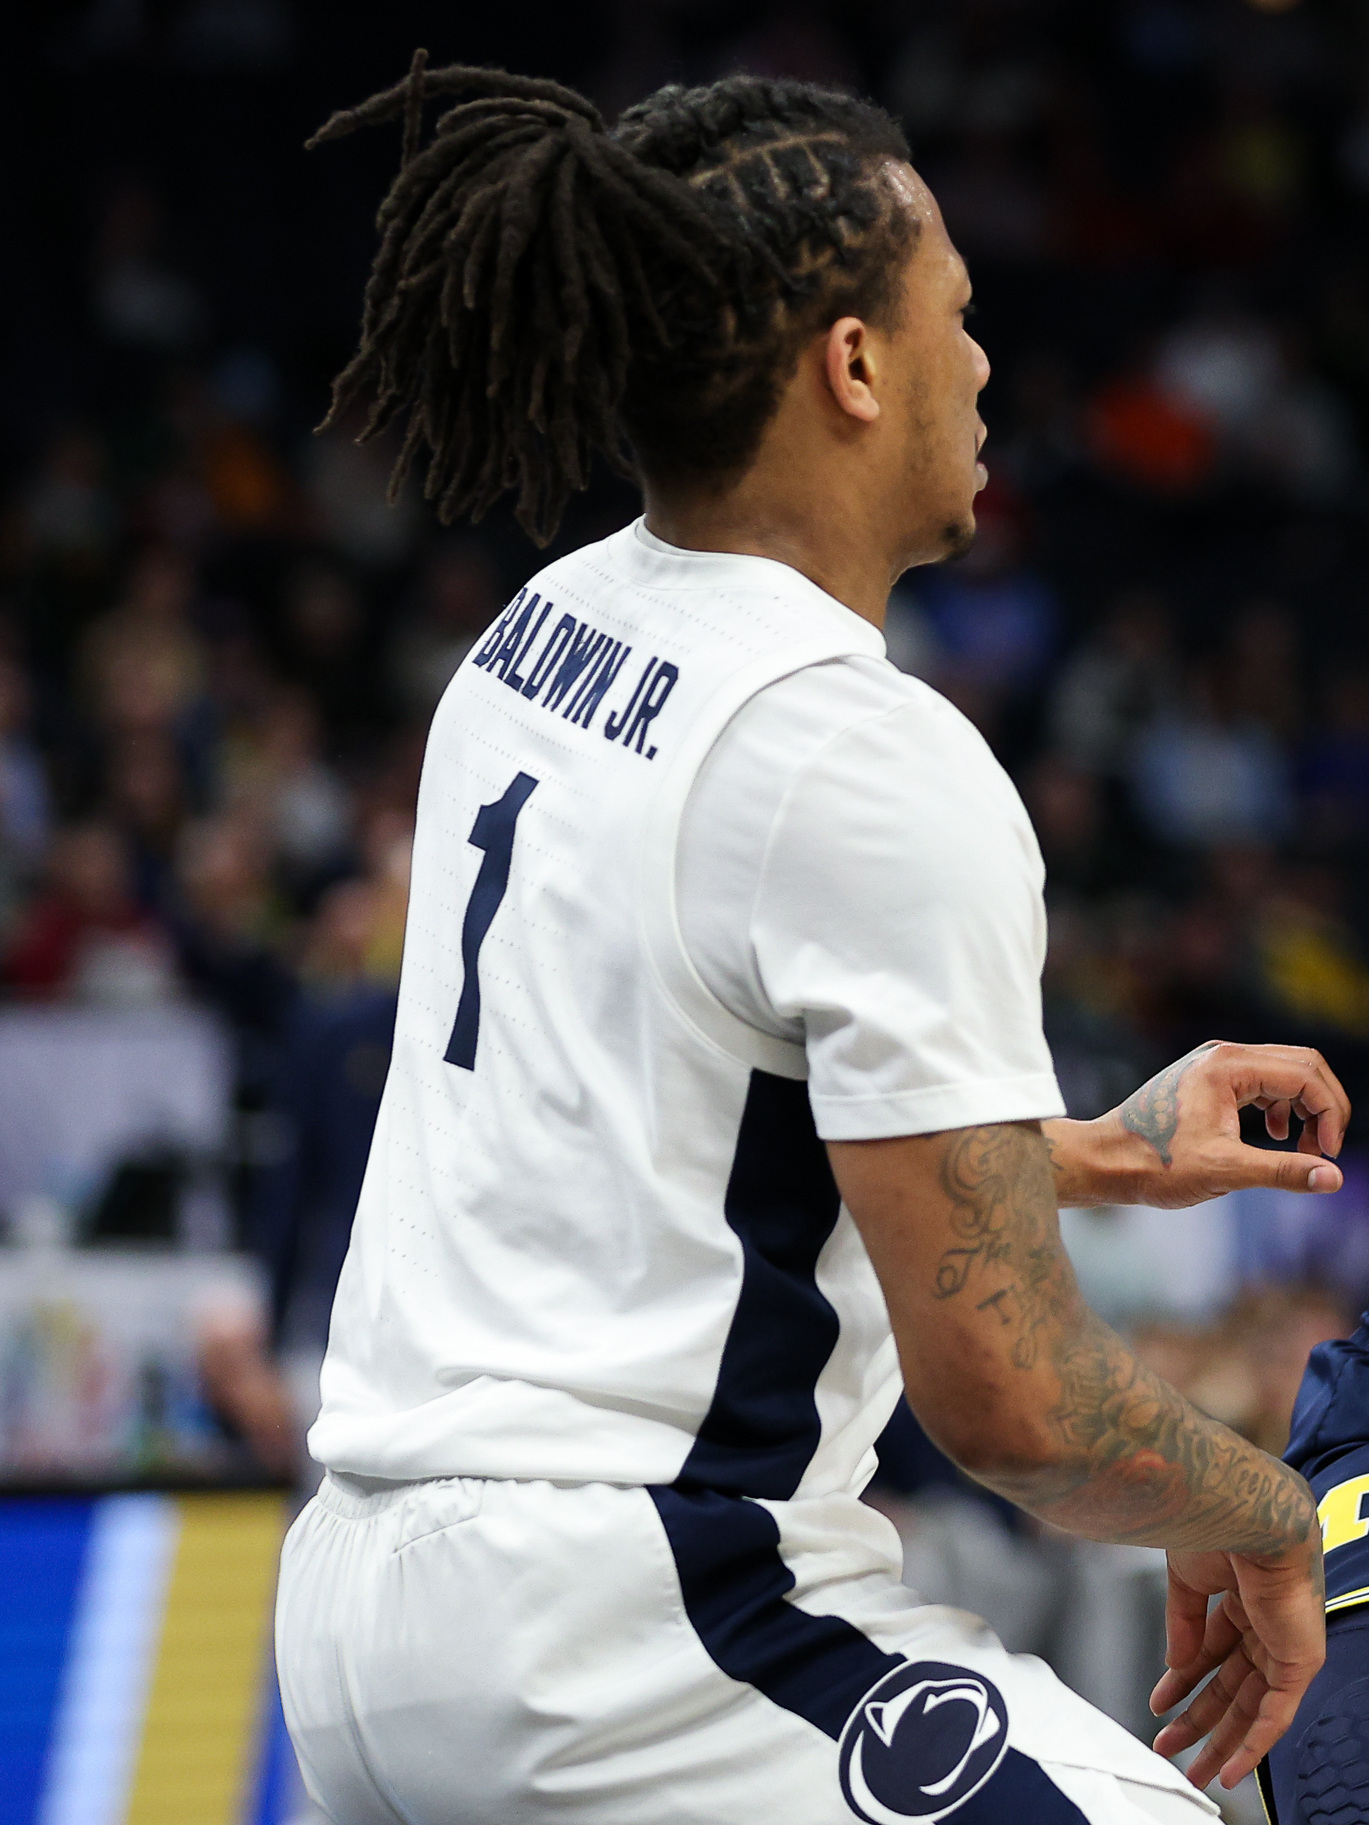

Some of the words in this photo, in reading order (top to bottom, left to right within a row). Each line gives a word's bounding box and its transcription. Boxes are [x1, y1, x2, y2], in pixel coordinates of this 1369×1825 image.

[472, 587, 632, 730] BALDWIN
[604, 656, 680, 761] JR.
[442, 771, 540, 1072] 1
